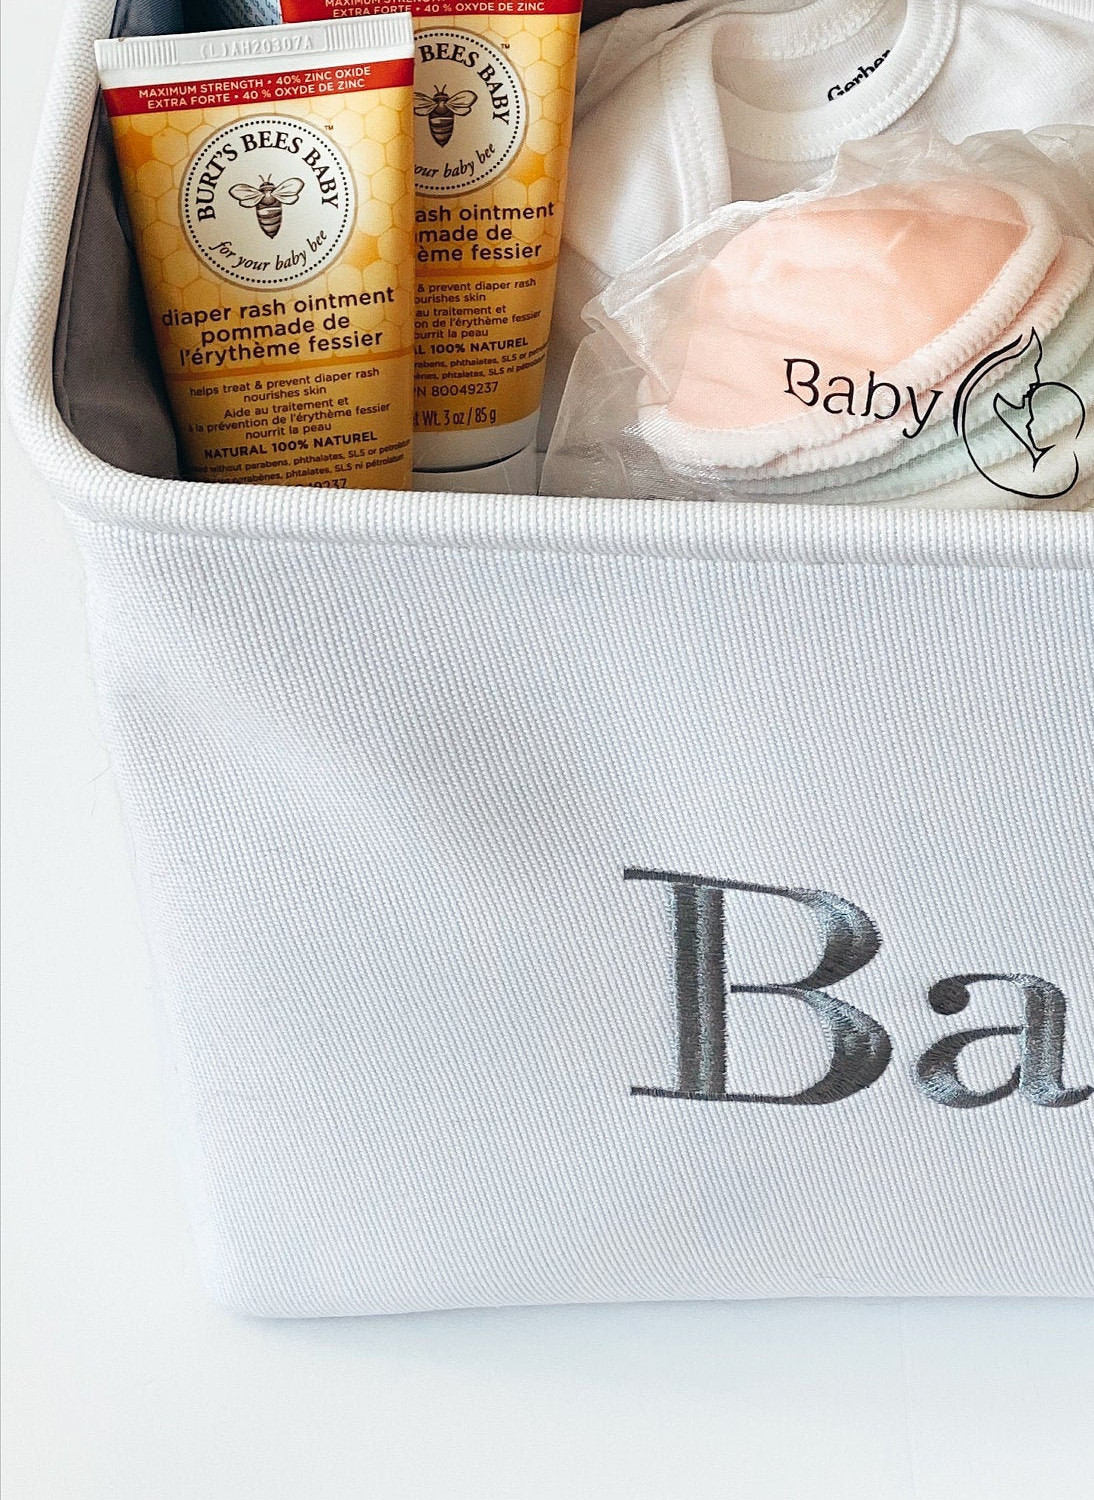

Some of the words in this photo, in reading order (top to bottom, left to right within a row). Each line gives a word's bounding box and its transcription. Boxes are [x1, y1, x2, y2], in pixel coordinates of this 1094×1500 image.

[333, 6, 371, 18] EXTRA
[374, 4, 411, 15] FORTE
[424, 4, 439, 13] 40
[457, 2, 495, 12] OXYDE
[498, 2, 514, 11] DE
[517, 2, 545, 11] ZINC
[139, 85, 197, 100] MAXIMUM
[200, 79, 264, 94] STRENGTH
[276, 74, 301, 86] 40%
[305, 71, 331, 83] ZINC
[335, 66, 371, 78] OXIDE
[418, 43, 480, 68] BEES
[477, 63, 510, 125] BABY
[147, 98, 187, 109] EXTRA
[191, 93, 230, 105] FORTE
[242, 90, 259, 100] 40
[275, 84, 315, 97] OXYDE
[319, 82, 334, 92] DE
[338, 79, 365, 90] ZINC
[443, 159, 475, 178] baby
[475, 143, 495, 164] bee
[196, 143, 238, 222] BURT'S
[240, 131, 303, 154] BEES
[302, 147, 339, 209] BABY
[415, 205, 451, 222] ash
[459, 201, 555, 221] ointment
[486, 224, 512, 241] de
[209, 241, 236, 259] for
[232, 256, 270, 271] your
[275, 250, 307, 271] baby
[306, 230, 327, 252] bee
[472, 243, 542, 261] fessier
[429, 282, 471, 296] prevent
[475, 281, 510, 293] diaper
[514, 278, 536, 289] rash
[161, 304, 232, 327] diaper
[240, 299, 286, 319] rash
[294, 286, 395, 313] ointment
[464, 293, 486, 302] skin
[416, 309, 429, 317] au
[433, 305, 491, 317] traitement
[495, 305, 506, 313] et
[432, 318, 446, 328] de
[512, 310, 541, 323] fessier
[201, 317, 314, 347] pommade
[323, 313, 350, 330] de
[448, 329, 457, 337] la
[461, 328, 488, 339] peau
[179, 339, 300, 366] l'érythème
[309, 330, 383, 353] fessier
[430, 344, 465, 355] 100%
[470, 337, 528, 351] NATUREL
[501, 354, 517, 363] SLS
[190, 386, 219, 399] helps
[223, 382, 250, 393] treat
[267, 375, 310, 390] prevent
[314, 371, 351, 385] diaper
[355, 367, 379, 379] rash
[431, 381, 499, 397] 80049237
[243, 388, 300, 403] nourishes
[303, 385, 327, 396] skin
[783, 358, 943, 439] Baby
[224, 406, 251, 419] Aide
[254, 406, 268, 415] au
[272, 398, 334, 414] traitement
[337, 397, 349, 406] et
[453, 413, 465, 424] oz
[475, 407, 487, 422] 85
[207, 416, 268, 434] prévention
[272, 414, 286, 425] de
[355, 402, 392, 416] fessier
[245, 427, 286, 440] nourrit
[289, 425, 299, 435] la
[303, 423, 332, 436] peau
[204, 444, 267, 460] NATURAL
[272, 438, 309, 452] 100%
[313, 431, 378, 448] NATUREL
[348, 450, 365, 460] SLS
[368, 448, 377, 456] or
[334, 463, 352, 473] SLS
